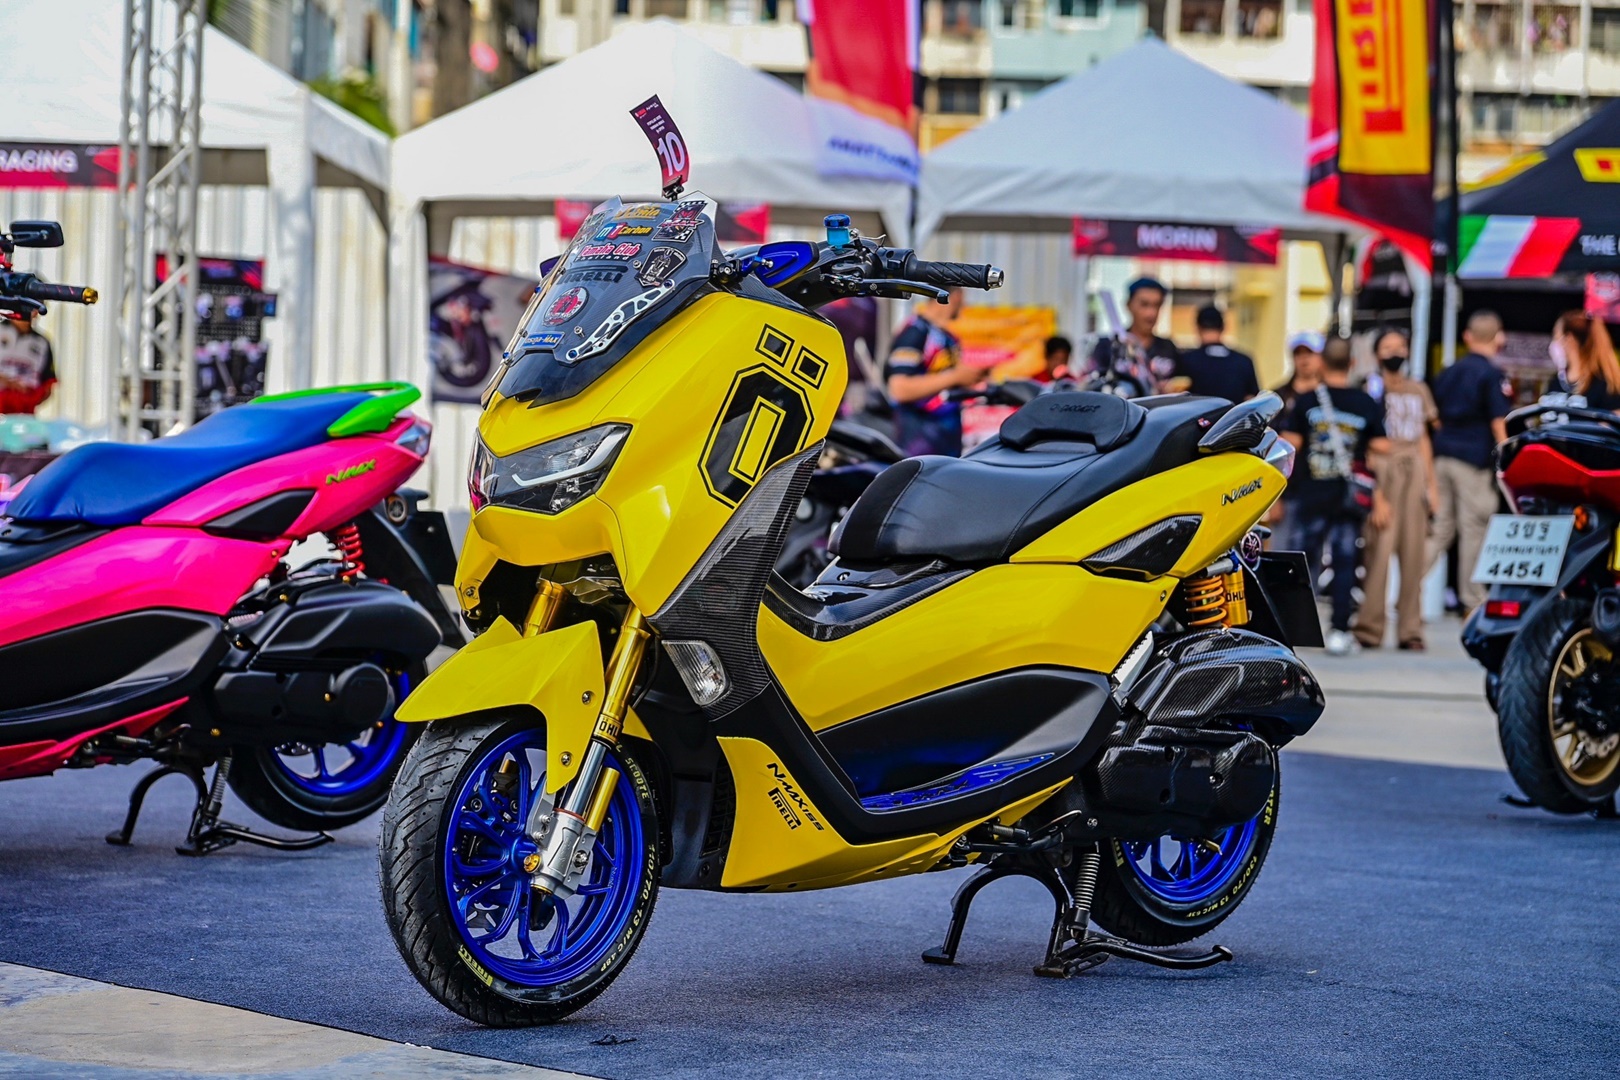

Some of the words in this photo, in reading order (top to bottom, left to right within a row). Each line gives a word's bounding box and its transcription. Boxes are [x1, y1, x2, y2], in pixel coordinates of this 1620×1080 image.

[657, 131, 685, 177] 10
[619, 227, 653, 235] Carbon
[1136, 224, 1218, 252] MORIN
[582, 243, 615, 257] Yamaha
[613, 242, 642, 257] Club
[1580, 235, 1617, 256] THE
[556, 264, 628, 285] PIRELLI
[1488, 561, 1544, 578] 4454
[767, 787, 802, 830] PIRELLI
